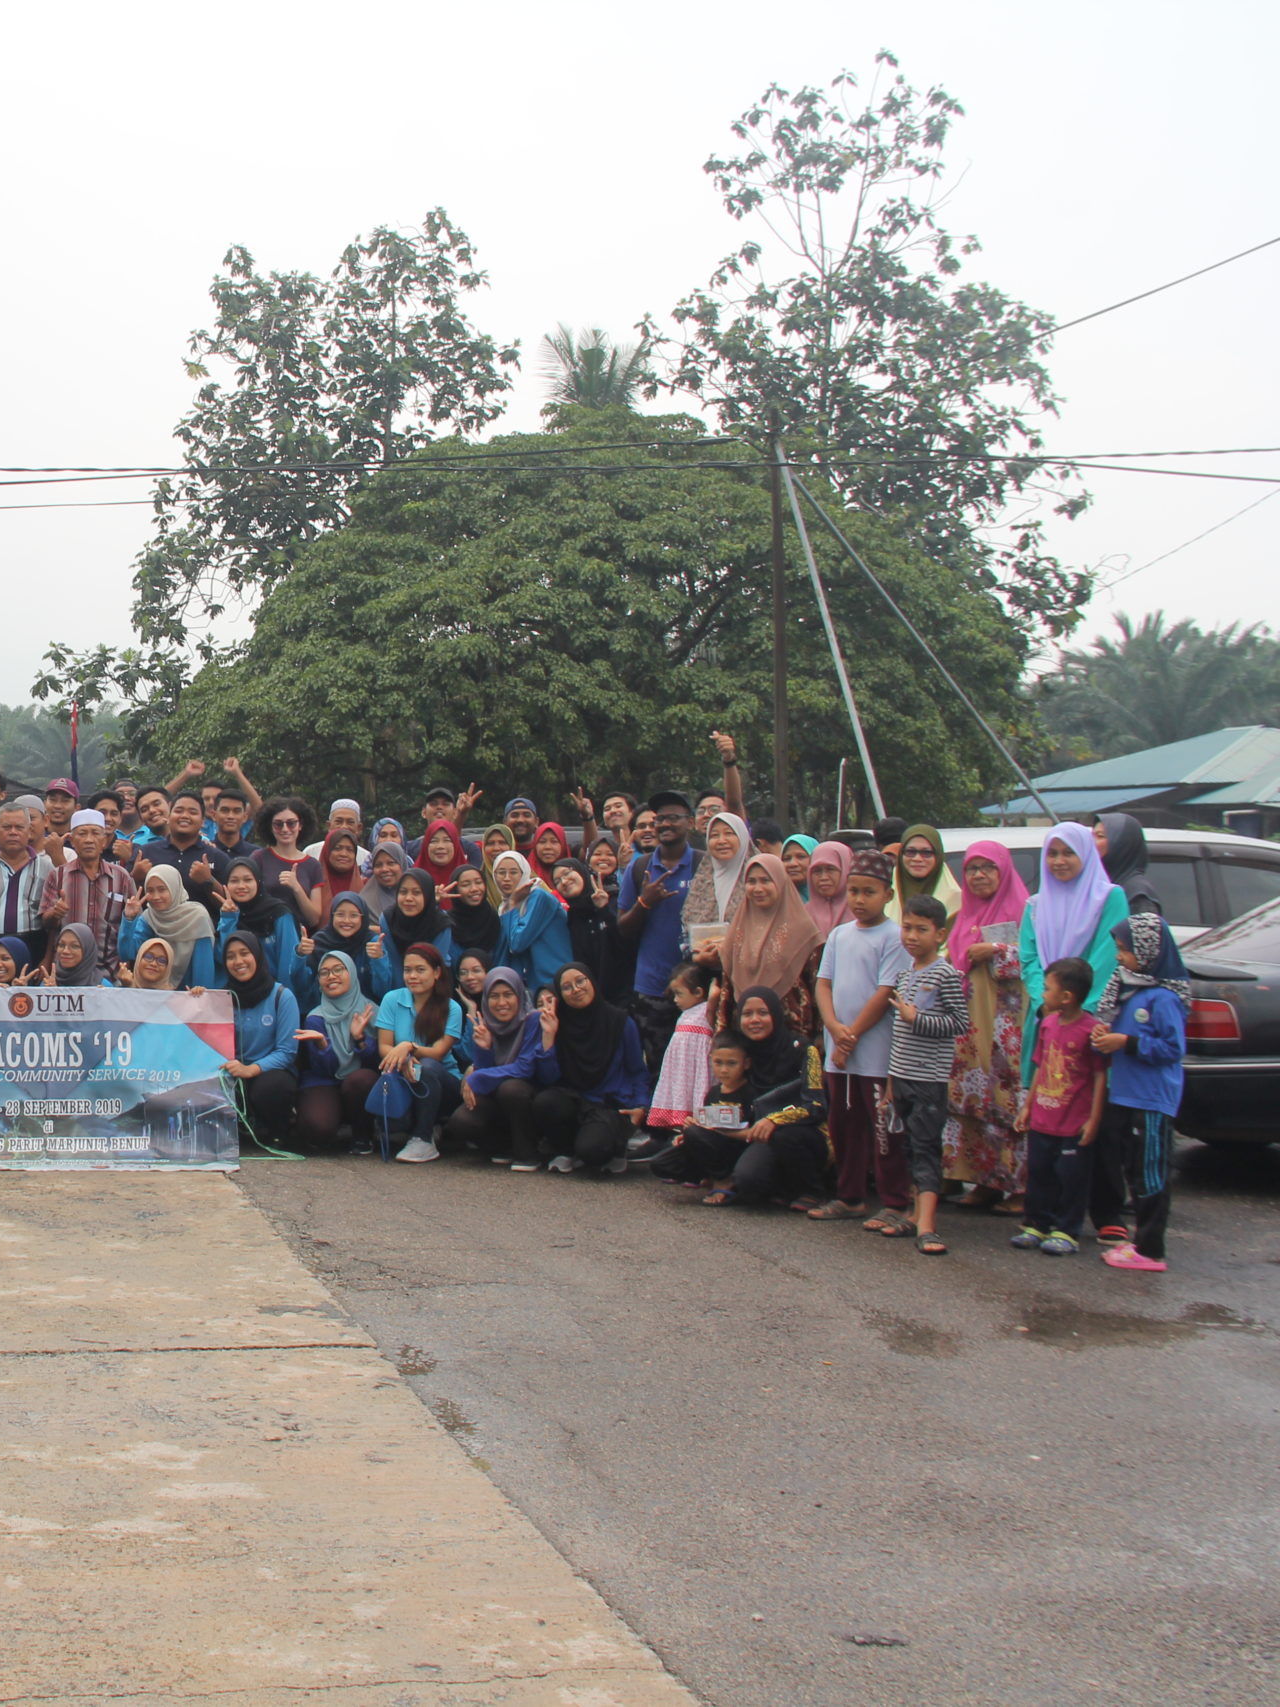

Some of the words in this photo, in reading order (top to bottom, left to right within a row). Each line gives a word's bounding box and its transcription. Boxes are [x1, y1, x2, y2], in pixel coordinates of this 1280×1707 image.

[36, 994, 85, 1013] UTM
[87, 1068, 146, 1081] SERVICE
[148, 1069, 181, 1082] 2019
[6, 1100, 19, 1115] 28
[24, 1099, 91, 1115] SEPTEMBER
[96, 1098, 121, 1114] 2019
[43, 1120, 53, 1133] di
[8, 1138, 44, 1152] PARIT
[47, 1137, 108, 1153] MARJUNIT,
[110, 1136, 150, 1151] BENUT
